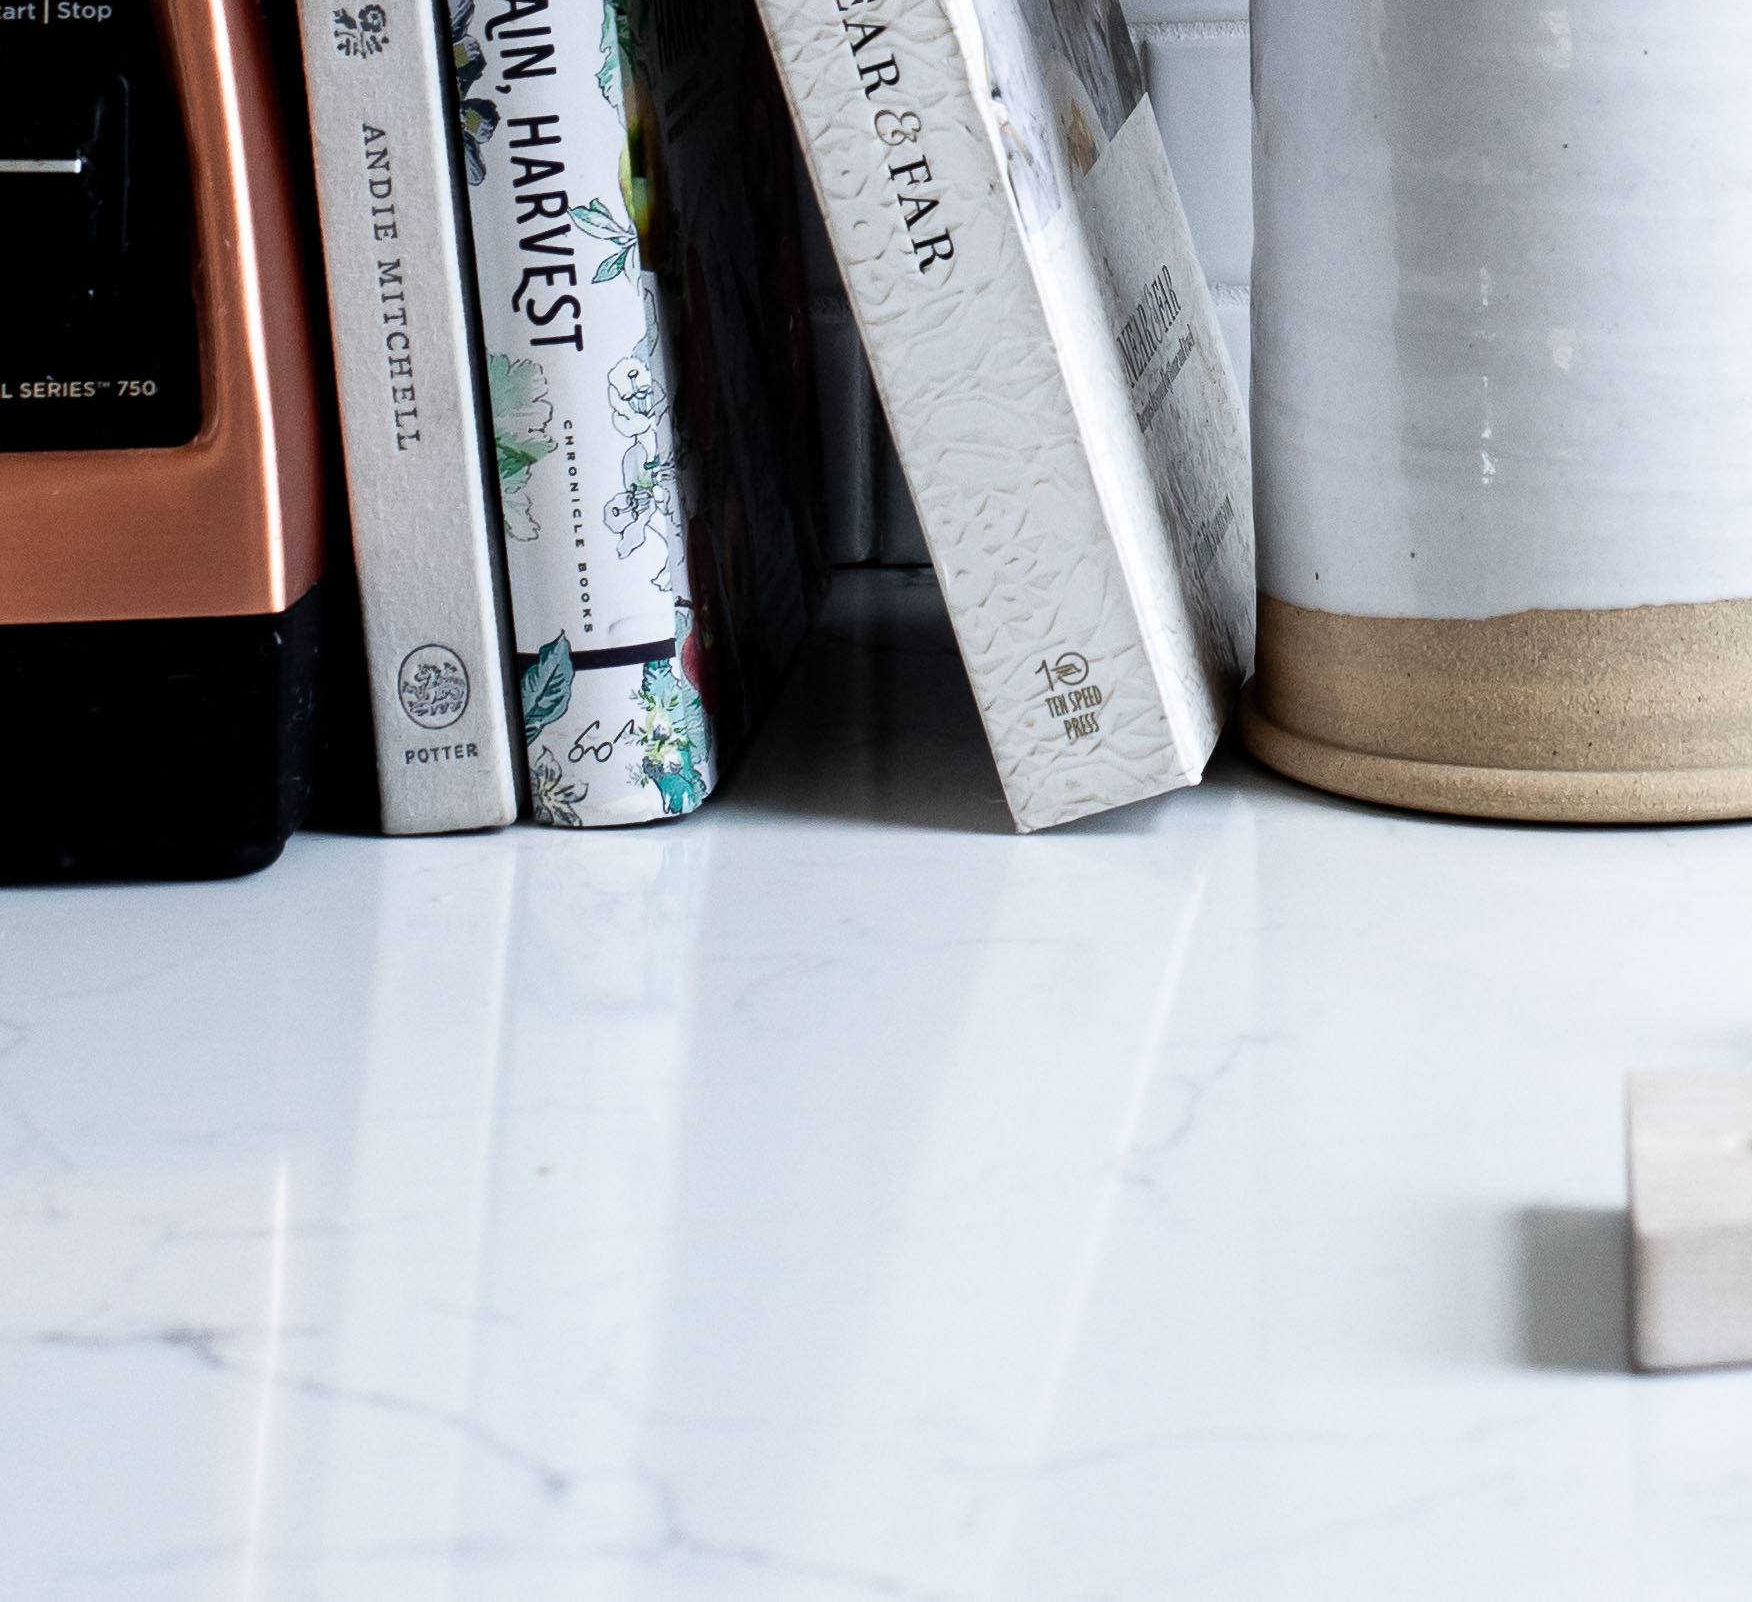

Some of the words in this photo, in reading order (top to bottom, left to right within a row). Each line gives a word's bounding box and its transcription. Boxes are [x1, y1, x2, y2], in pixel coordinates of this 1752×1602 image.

[0, 2, 37, 20] art
[57, 1, 113, 22] Stop
[873, 108, 922, 147] &
[362, 123, 398, 241] ANDIE
[887, 154, 955, 276] FAR
[491, 114, 584, 352] HARVEST
[377, 258, 420, 452] MITCHELL
[1116, 303, 1158, 389] NEAR
[1151, 264, 1182, 334] FAR
[117, 380, 157, 397] 750
[563, 419, 585, 548] CHRONICLE
[578, 562, 593, 633] BOOKS
[1045, 694, 1069, 718] TEN
[1068, 685, 1102, 713] SPEED
[1063, 711, 1100, 740] PRESS
[405, 743, 478, 764] POTTER
